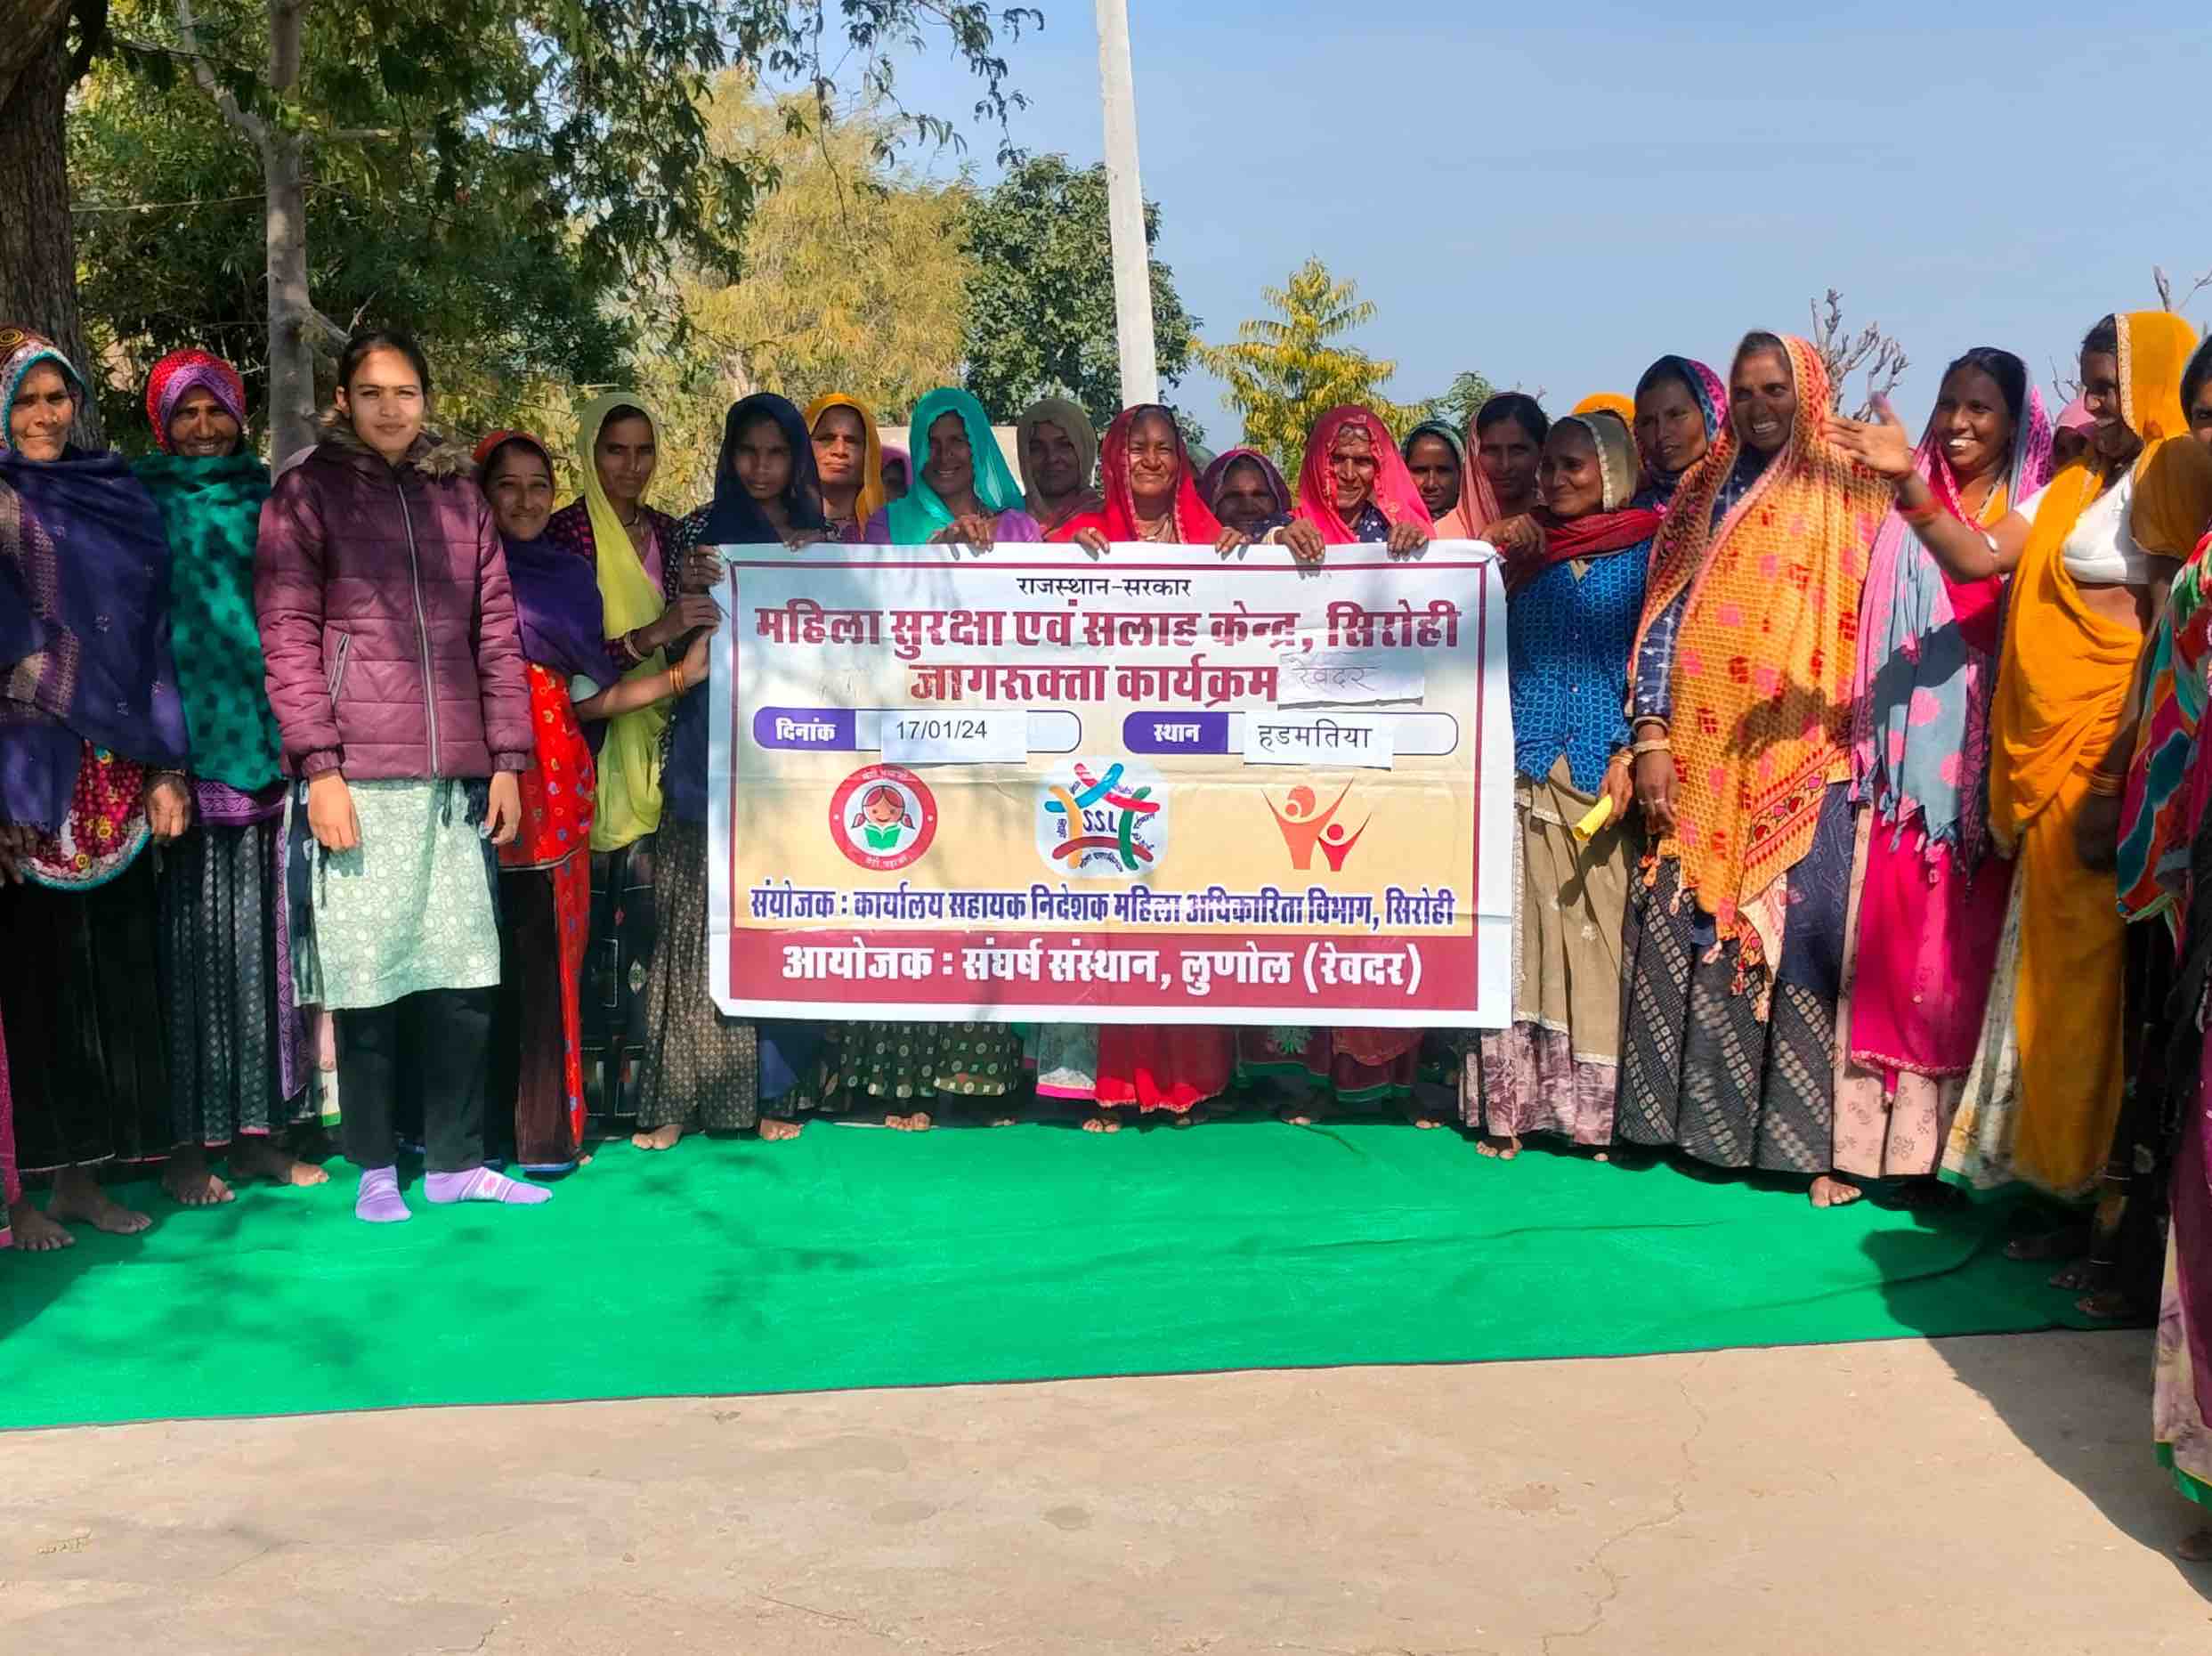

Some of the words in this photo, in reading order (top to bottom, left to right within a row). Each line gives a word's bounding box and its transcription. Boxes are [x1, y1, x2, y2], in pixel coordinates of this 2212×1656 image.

[1017, 578, 1191, 597] राजस्थान-सरकार
[755, 598, 883, 645] महिला
[890, 610, 1007, 660] सुरक्षा
[1012, 598, 1077, 646] एवं
[1082, 613, 1202, 647] सलाह
[1326, 599, 1461, 648] सिरोही
[1115, 654, 1278, 708] कार्यक्रम
[775, 716, 838, 742] दिनांक
[896, 719, 988, 740] 17/01/24
[1154, 723, 1202, 743] स्थान
[1257, 718, 1373, 752] हडमतिया
[751, 880, 836, 919] संयोजक
[854, 881, 944, 920] कार्यालय
[949, 892, 1027, 921] सहायक
[1031, 883, 1110, 921] निदेशक
[1114, 885, 1182, 923] महिला
[1308, 887, 1379, 931] विभाग,
[1386, 887, 1454, 926] सिरोही
[783, 937, 935, 980] आयोजक
[961, 937, 1043, 981] संघर्ष
[1049, 938, 1172, 991] संस्थान,
[1180, 940, 1295, 996] लुणोल
[1302, 941, 1422, 996] (रेवदर)
